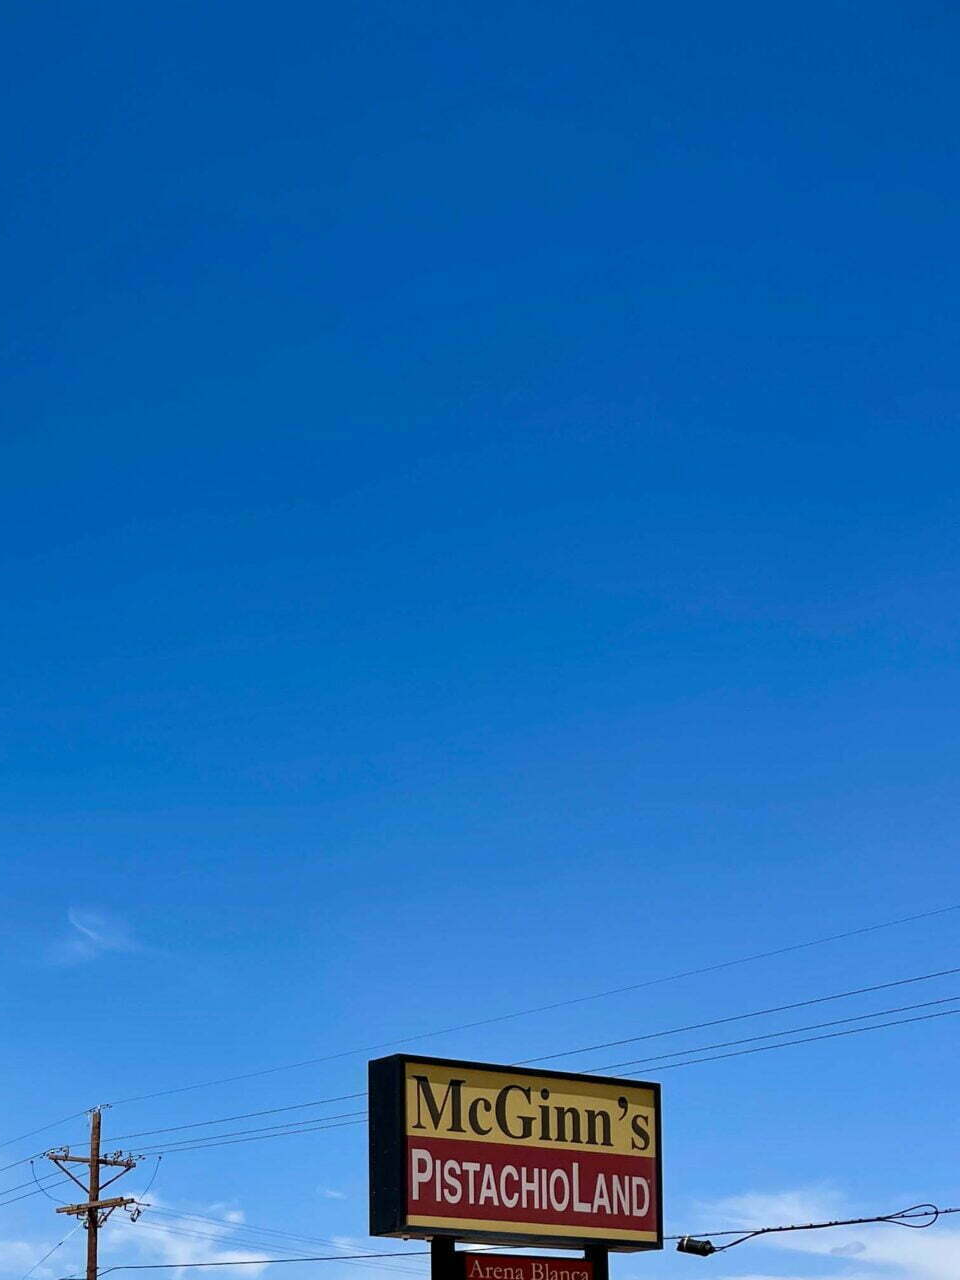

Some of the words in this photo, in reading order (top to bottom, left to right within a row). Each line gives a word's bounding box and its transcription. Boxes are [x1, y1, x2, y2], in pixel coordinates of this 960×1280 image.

[412, 1075, 650, 1151] McGinn's
[411, 1148, 650, 1217] PISTACHIOLAND
[468, 1260, 524, 1280] Arena
